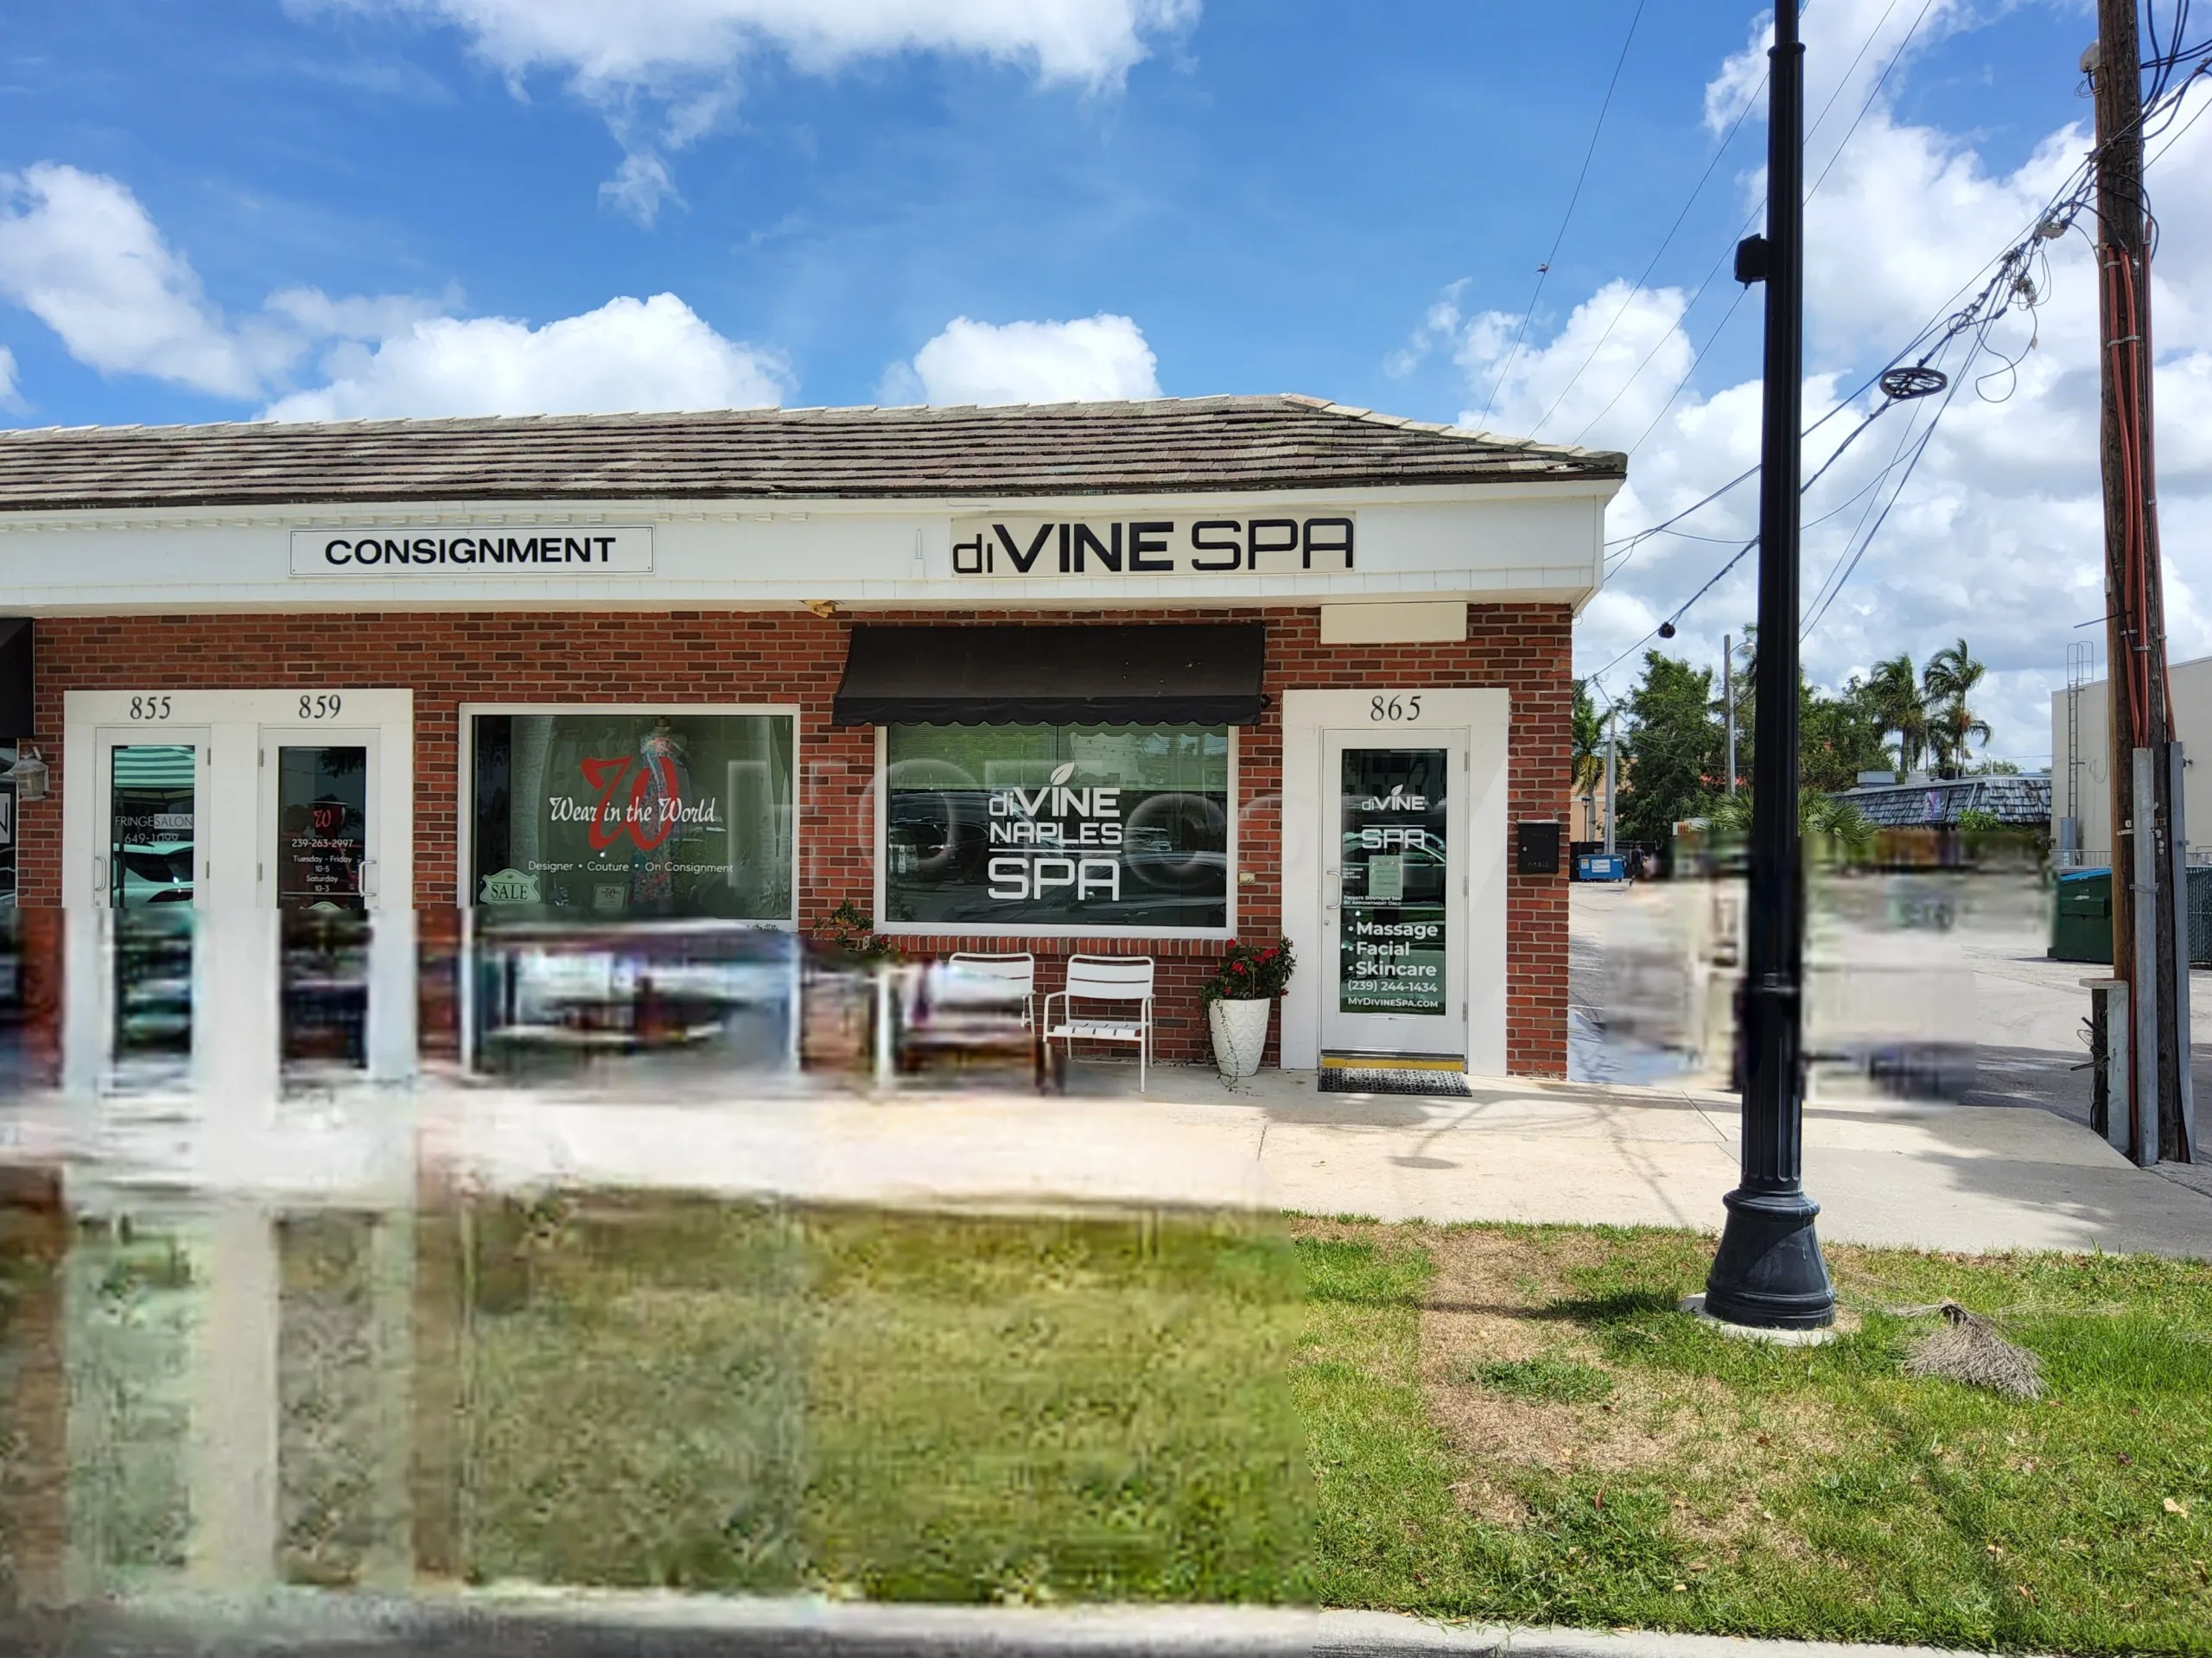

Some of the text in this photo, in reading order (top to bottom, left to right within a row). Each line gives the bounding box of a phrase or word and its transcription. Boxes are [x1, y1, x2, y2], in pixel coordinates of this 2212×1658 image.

[325, 537, 616, 565] CONSIGNMENT
[953, 518, 1354, 574] diVINE SPA
[130, 696, 171, 720] 855
[298, 695, 341, 719] 859
[1370, 696, 1421, 721] 865
[549, 796, 716, 823] Wear in the World
[988, 786, 1121, 817] diVINE
[1361, 796, 1426, 810] diVINE
[291, 838, 354, 848] 239-263-2997
[989, 822, 1122, 845] NAPLES
[1361, 829, 1426, 848] SPA
[293, 855, 323, 864] Tuesday
[329, 855, 353, 864] Friday
[528, 861, 734, 874] Designer Couture On Consignment
[306, 874, 339, 884] Saturday
[988, 857, 1120, 901] SPA
[490, 884, 528, 900] SALE
[1356, 921, 1439, 940] Massage
[1356, 940, 1410, 956] Facial
[1355, 960, 1438, 977] Skincare
[1348, 979, 1438, 993] (239) 244-1434
